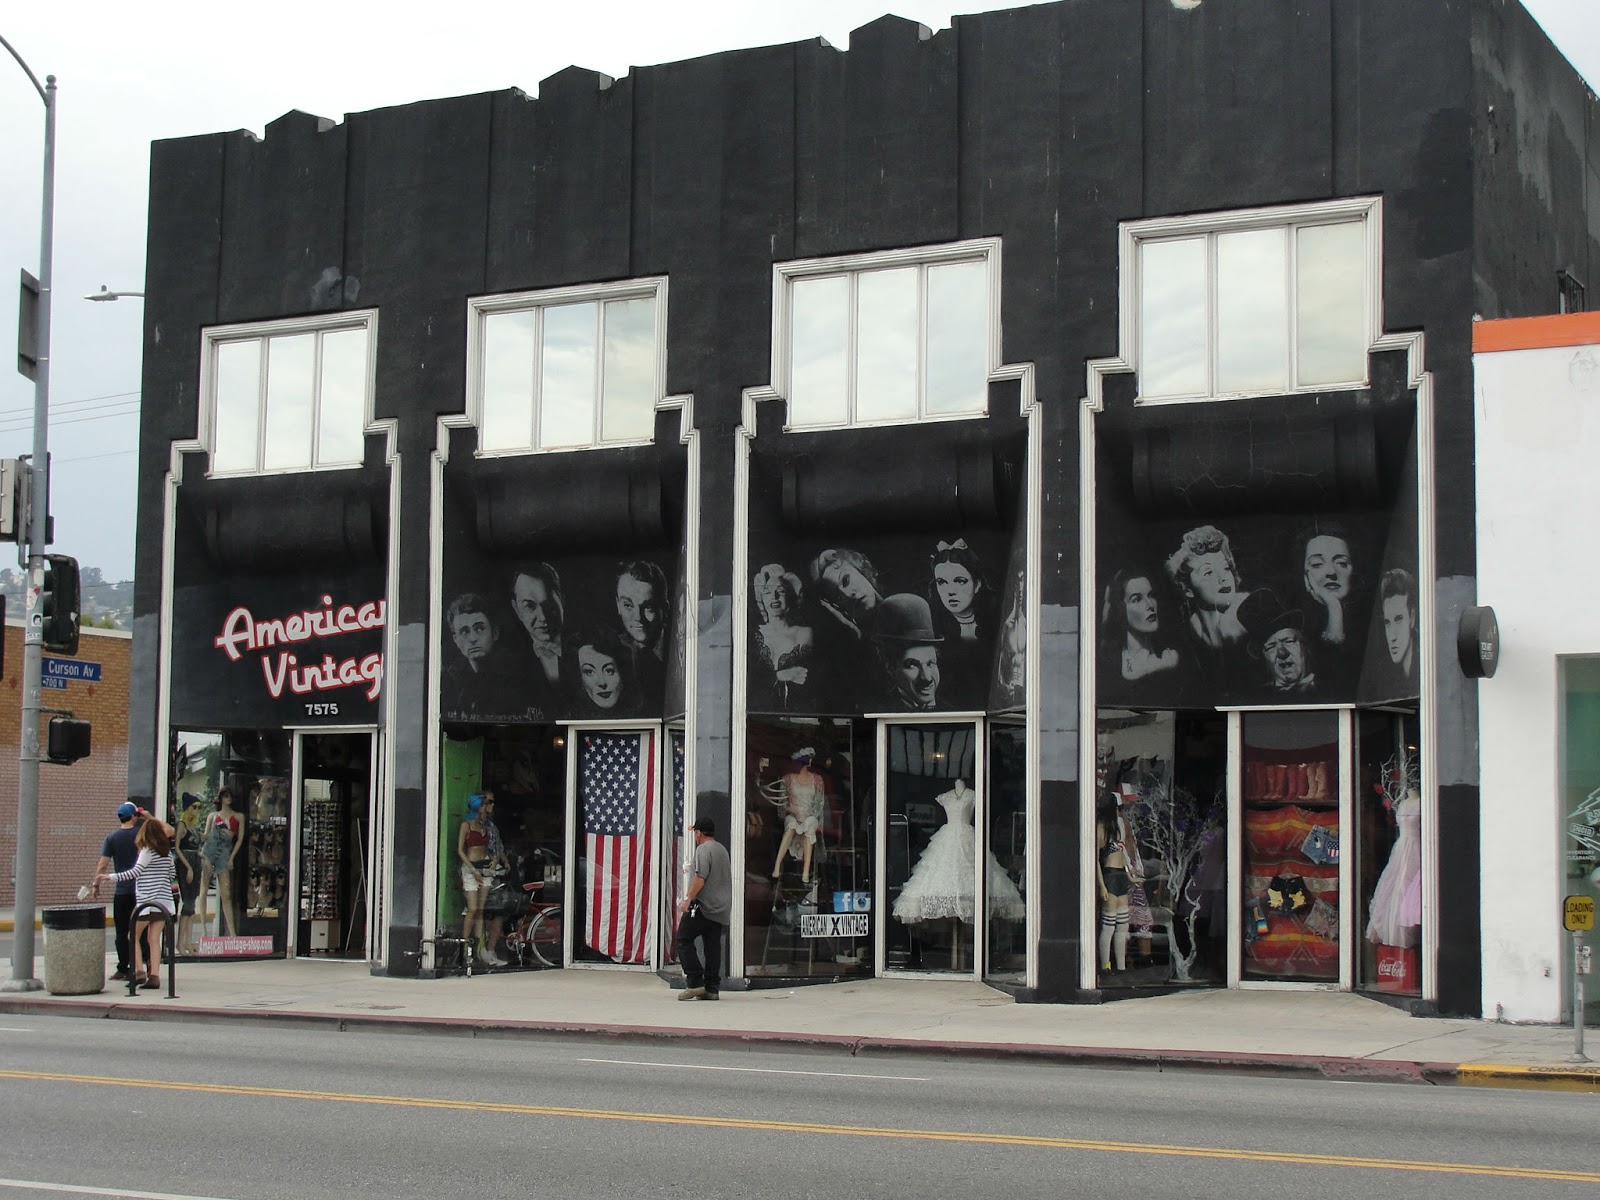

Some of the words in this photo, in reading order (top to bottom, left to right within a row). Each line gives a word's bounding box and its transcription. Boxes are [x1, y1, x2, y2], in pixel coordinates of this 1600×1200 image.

[48, 660, 80, 676] Curson
[83, 665, 94, 677] Av
[261, 650, 384, 701] Vintag
[45, 678, 57, 688] 700
[305, 703, 339, 716] 7575
[1567, 902, 1594, 913] LOADING
[802, 915, 828, 936] AMERICAN
[831, 916, 841, 936] X
[841, 915, 867, 936] VINTAGE
[1571, 914, 1587, 924] ONLY
[199, 936, 224, 955] American
